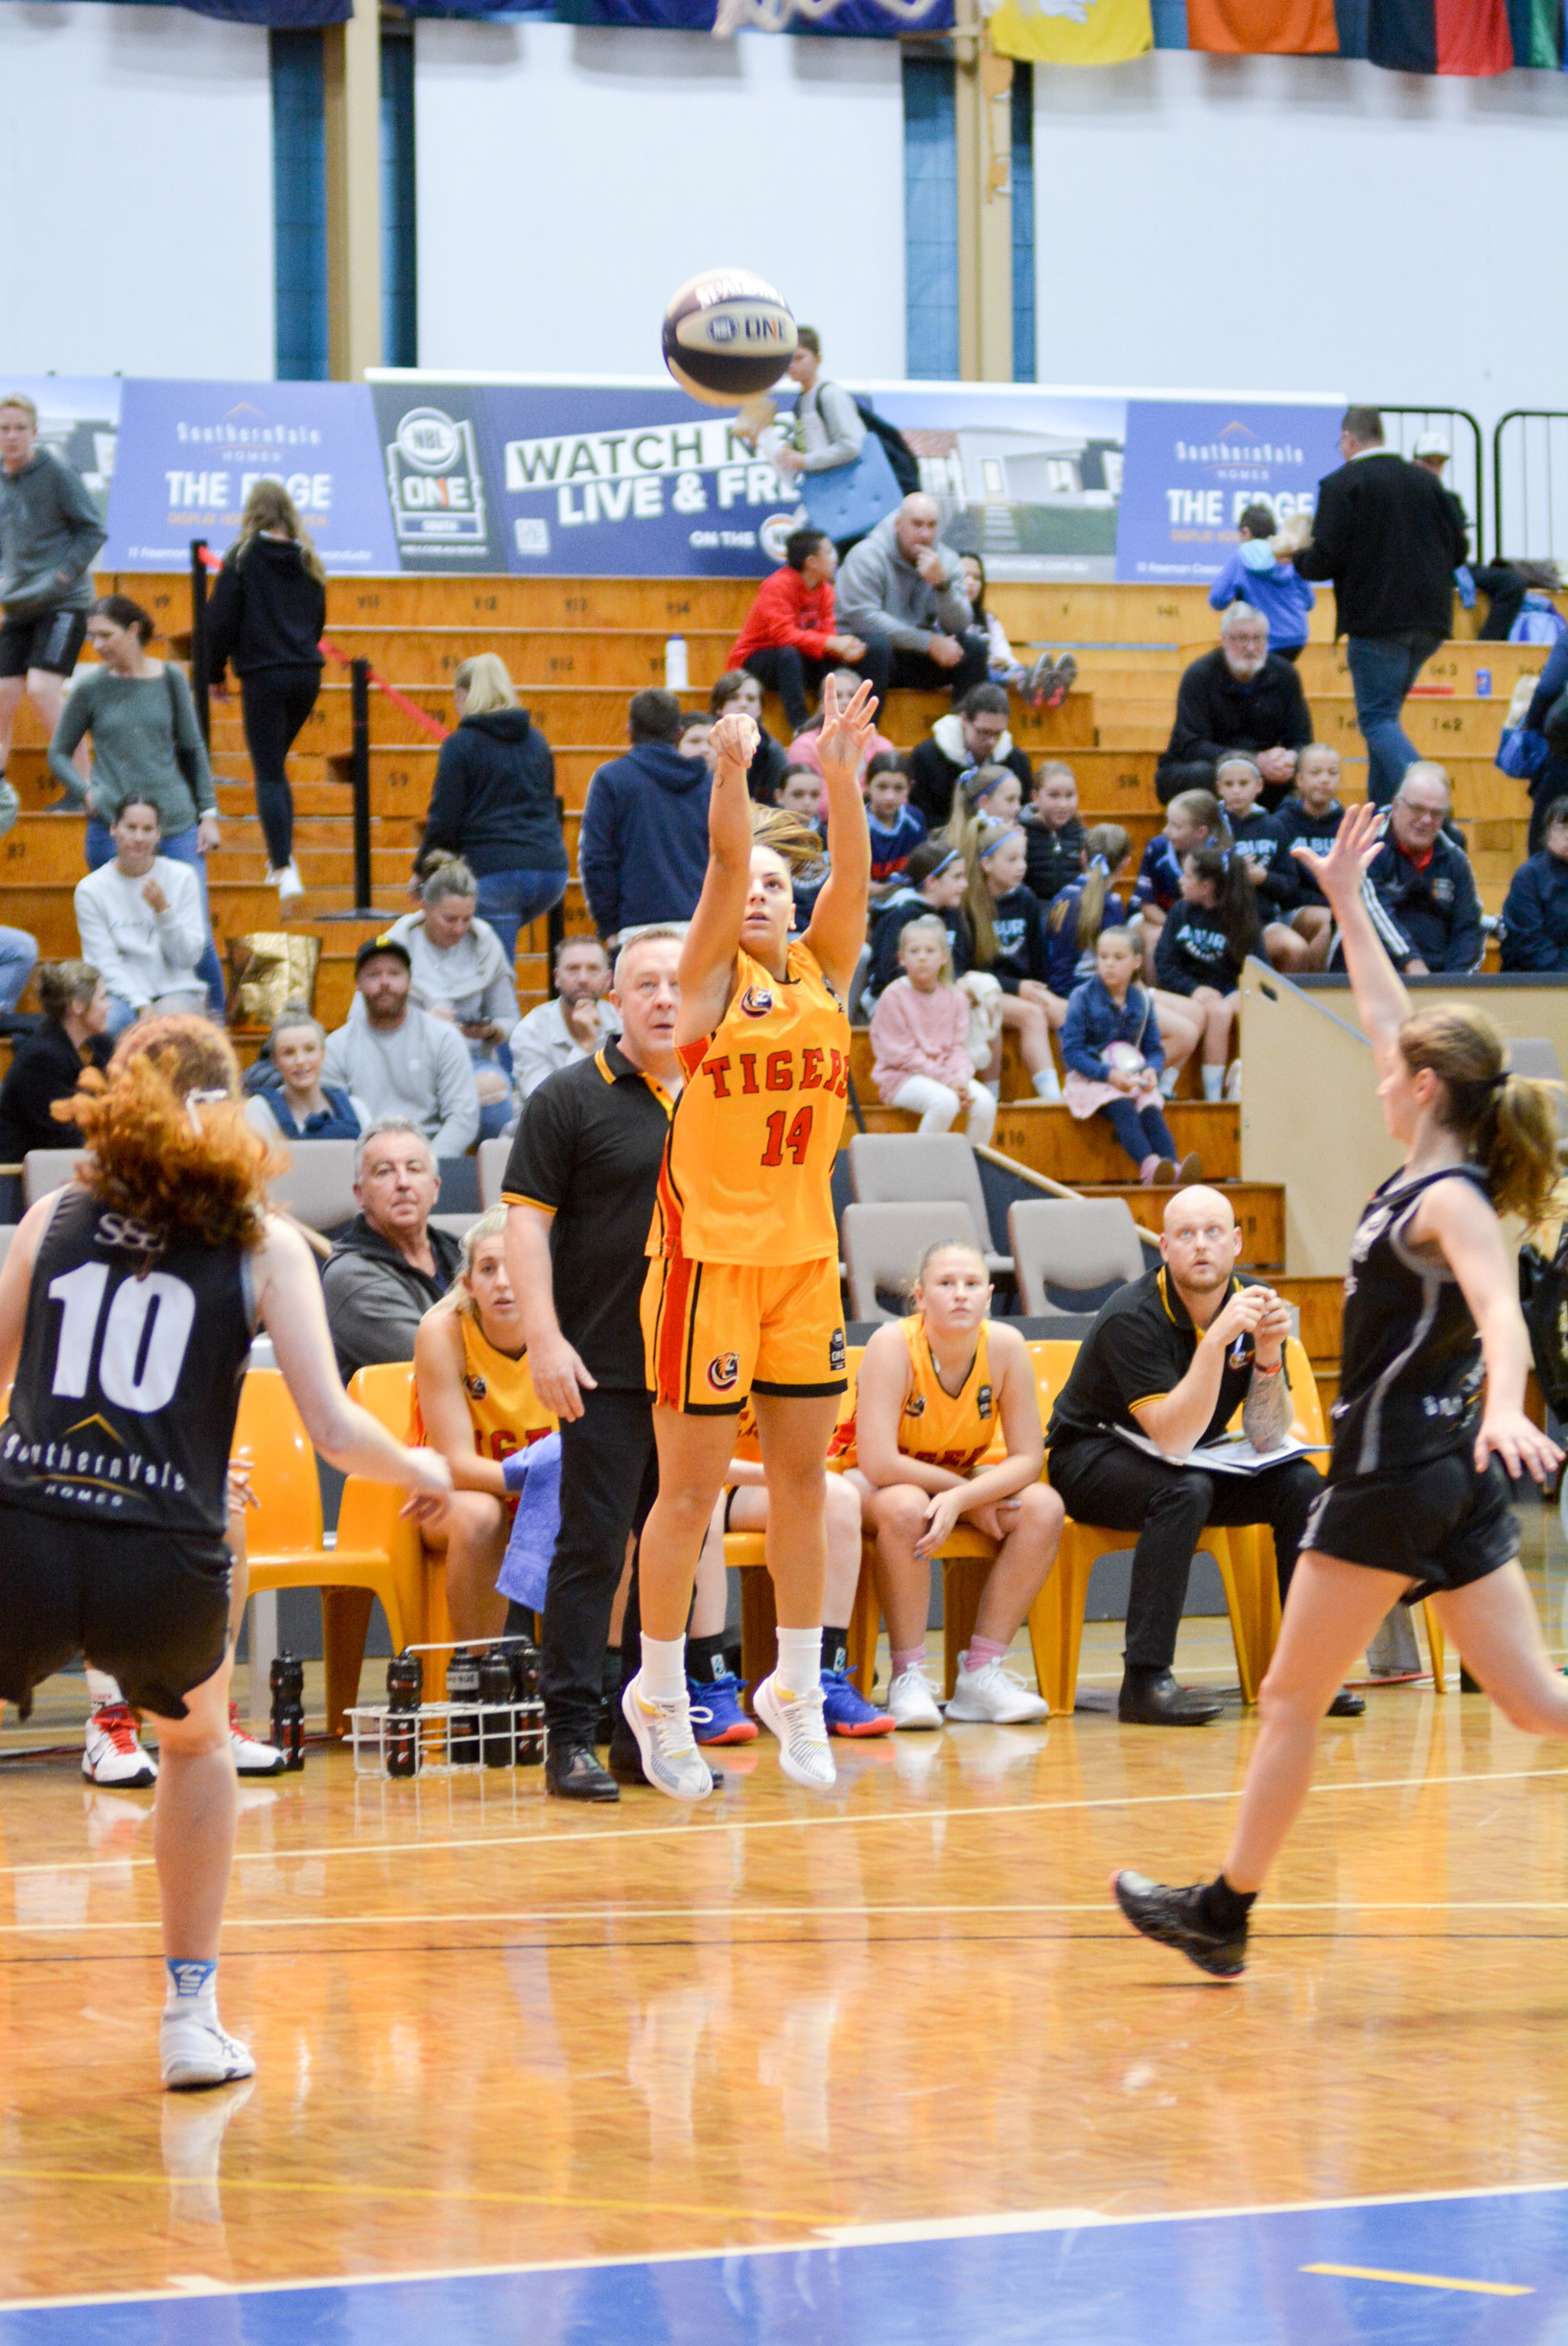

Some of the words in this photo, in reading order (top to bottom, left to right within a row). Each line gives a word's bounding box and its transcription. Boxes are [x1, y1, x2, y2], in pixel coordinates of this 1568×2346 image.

[411, 428, 444, 450] NBL
[515, 426, 704, 483] WATCH
[165, 470, 230, 508] THE
[403, 476, 469, 508] ONE
[557, 476, 665, 526] LIVE
[672, 471, 708, 515] &
[1166, 488, 1224, 526] THE
[689, 530, 717, 549] ON
[719, 529, 756, 548] THE
[761, 1105, 813, 1167] 14
[48, 1260, 196, 1415] 10
[3, 1433, 186, 1493] SouthernVale
[44, 1484, 124, 1509] HOMES
